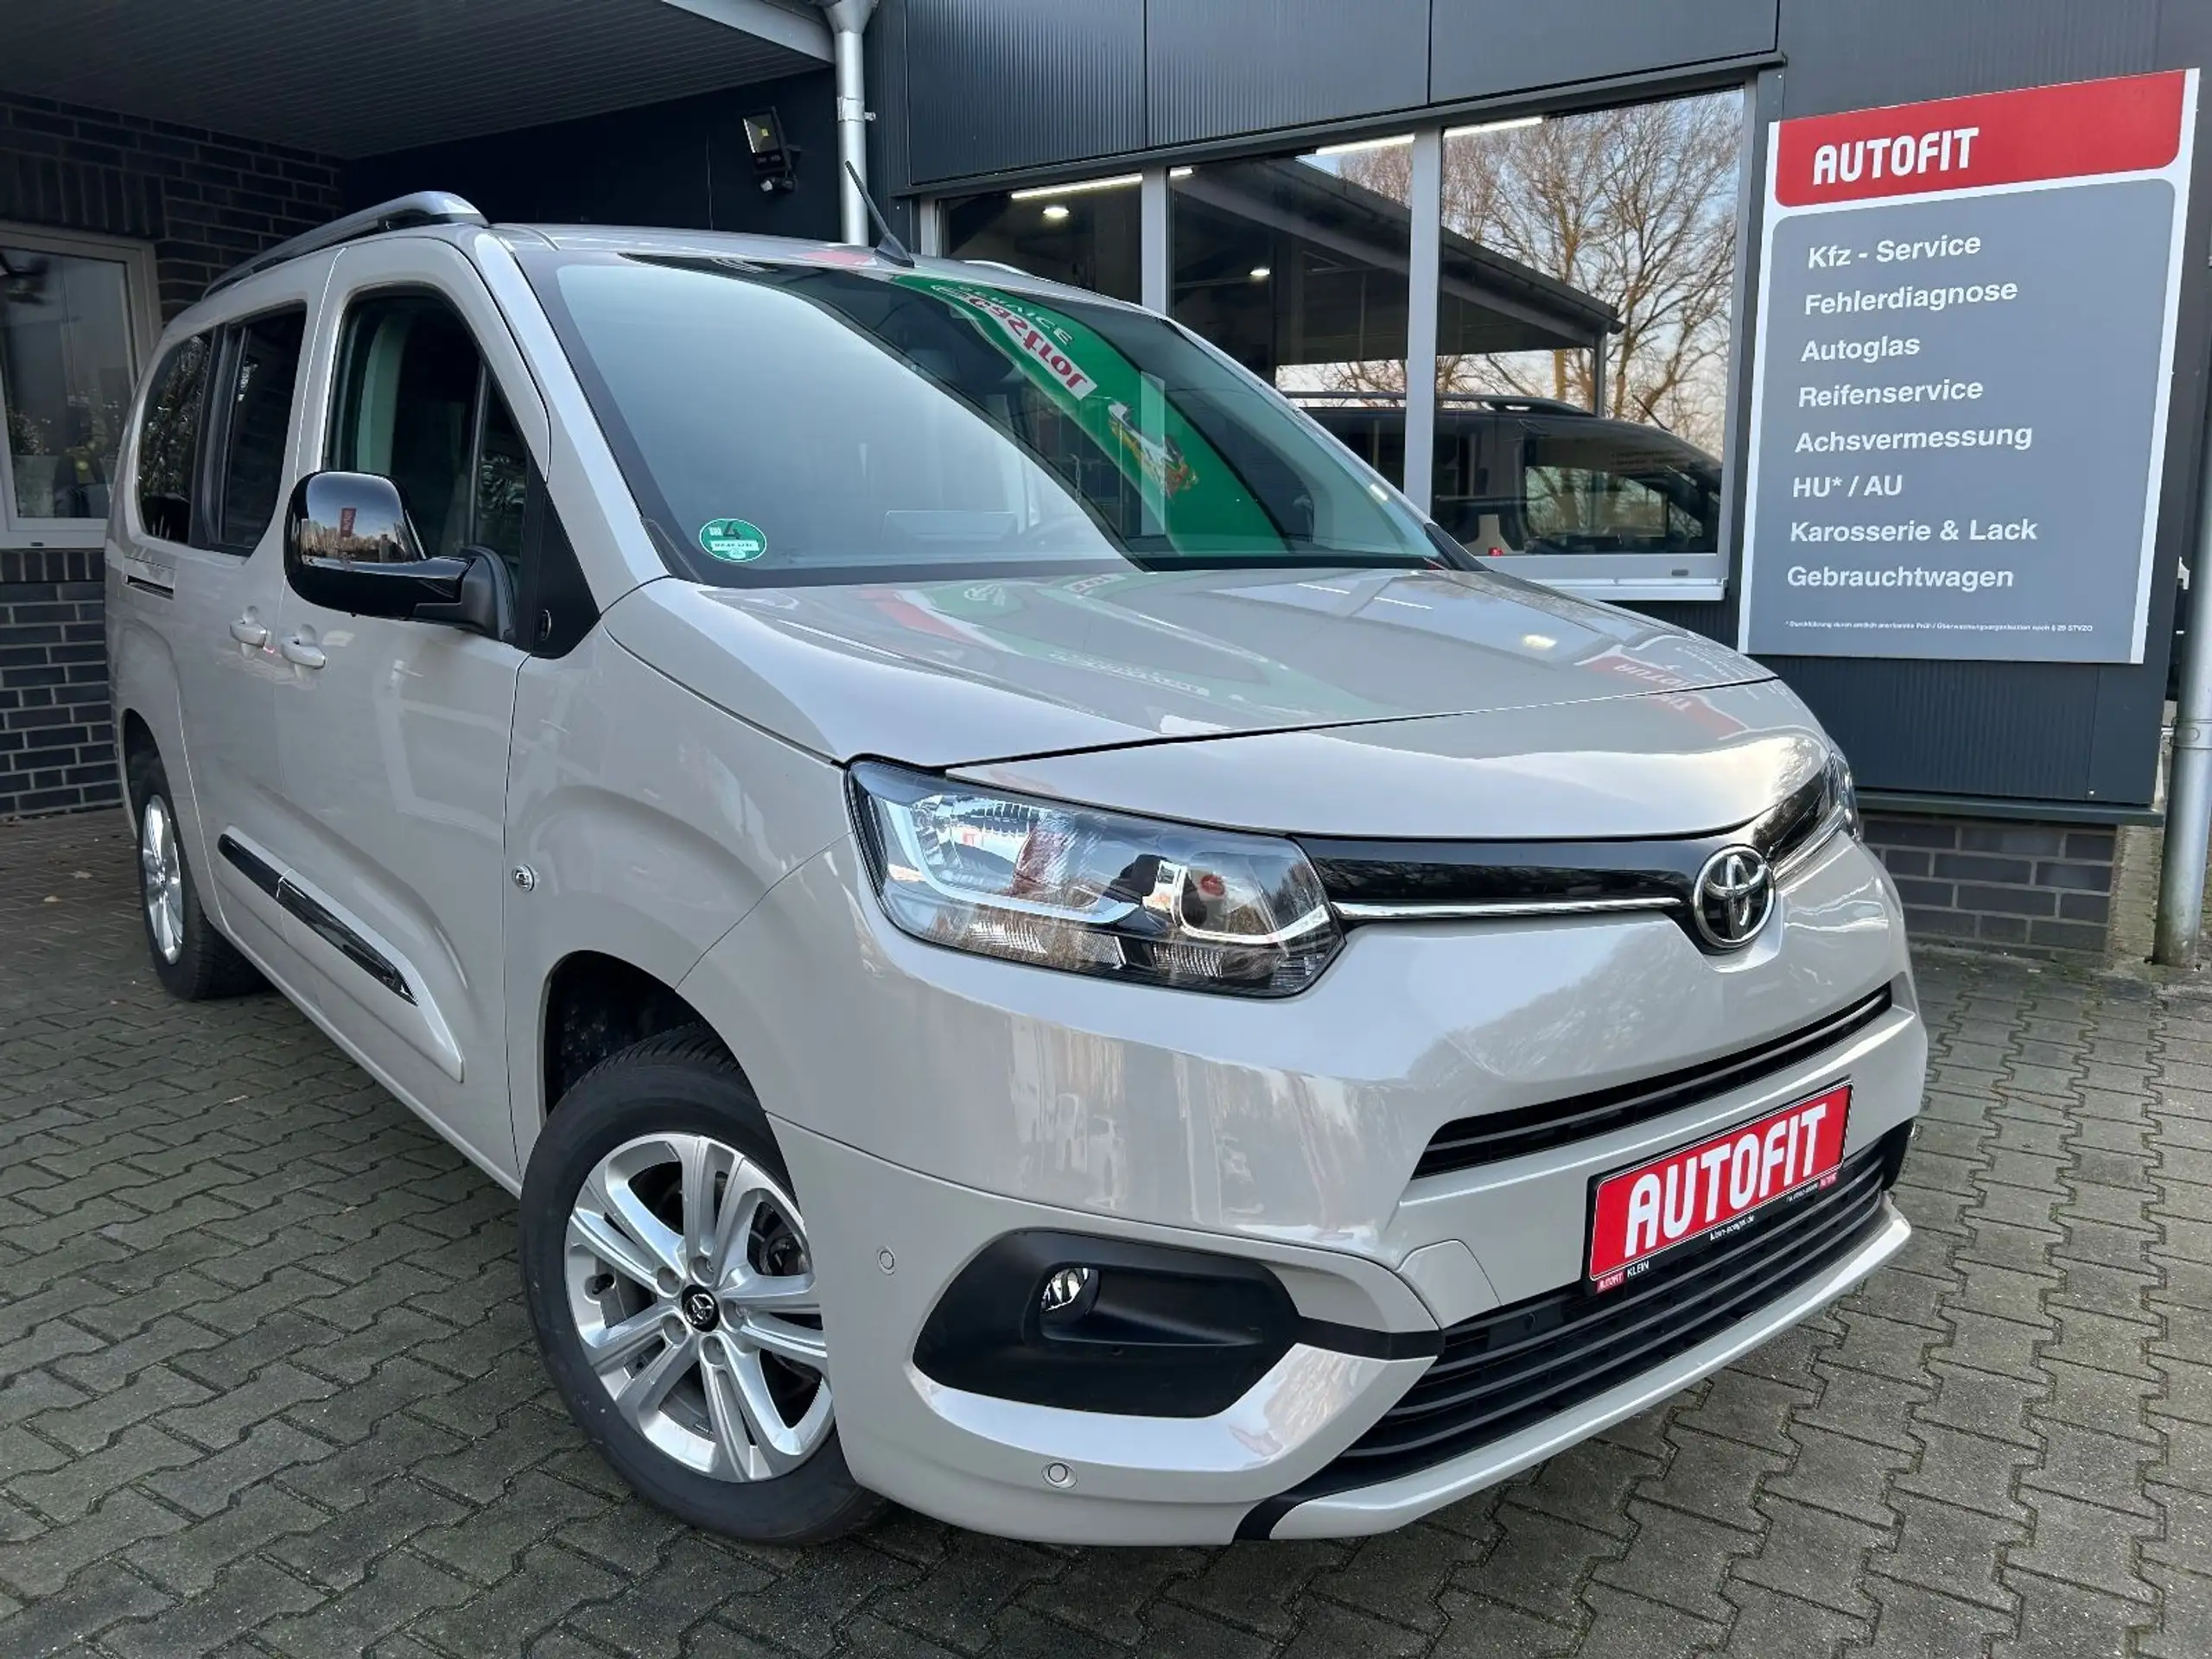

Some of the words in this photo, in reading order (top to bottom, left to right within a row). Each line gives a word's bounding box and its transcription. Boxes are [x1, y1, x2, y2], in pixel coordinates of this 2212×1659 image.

[1813, 127, 1980, 186] AUTOFIT
[1808, 245, 1852, 269] Kfz
[1876, 234, 1981, 263] Service
[1805, 282, 2018, 315] Fehlerdiagnose
[1800, 335, 1921, 364] Autoglas
[1798, 378, 1984, 408] Reifenservice
[1794, 427, 2032, 454] Achsvermessung
[1847, 475, 1859, 498] /
[1863, 474, 1903, 496] AU
[1789, 520, 1931, 543] Karosserie
[1939, 520, 1959, 541] &
[1969, 518, 2038, 541] Lack
[1787, 565, 2014, 593] Gebrauchtwagen
[1624, 1103, 1827, 1259] AUTOFIT
[1627, 1260, 1649, 1278] KLEIN
